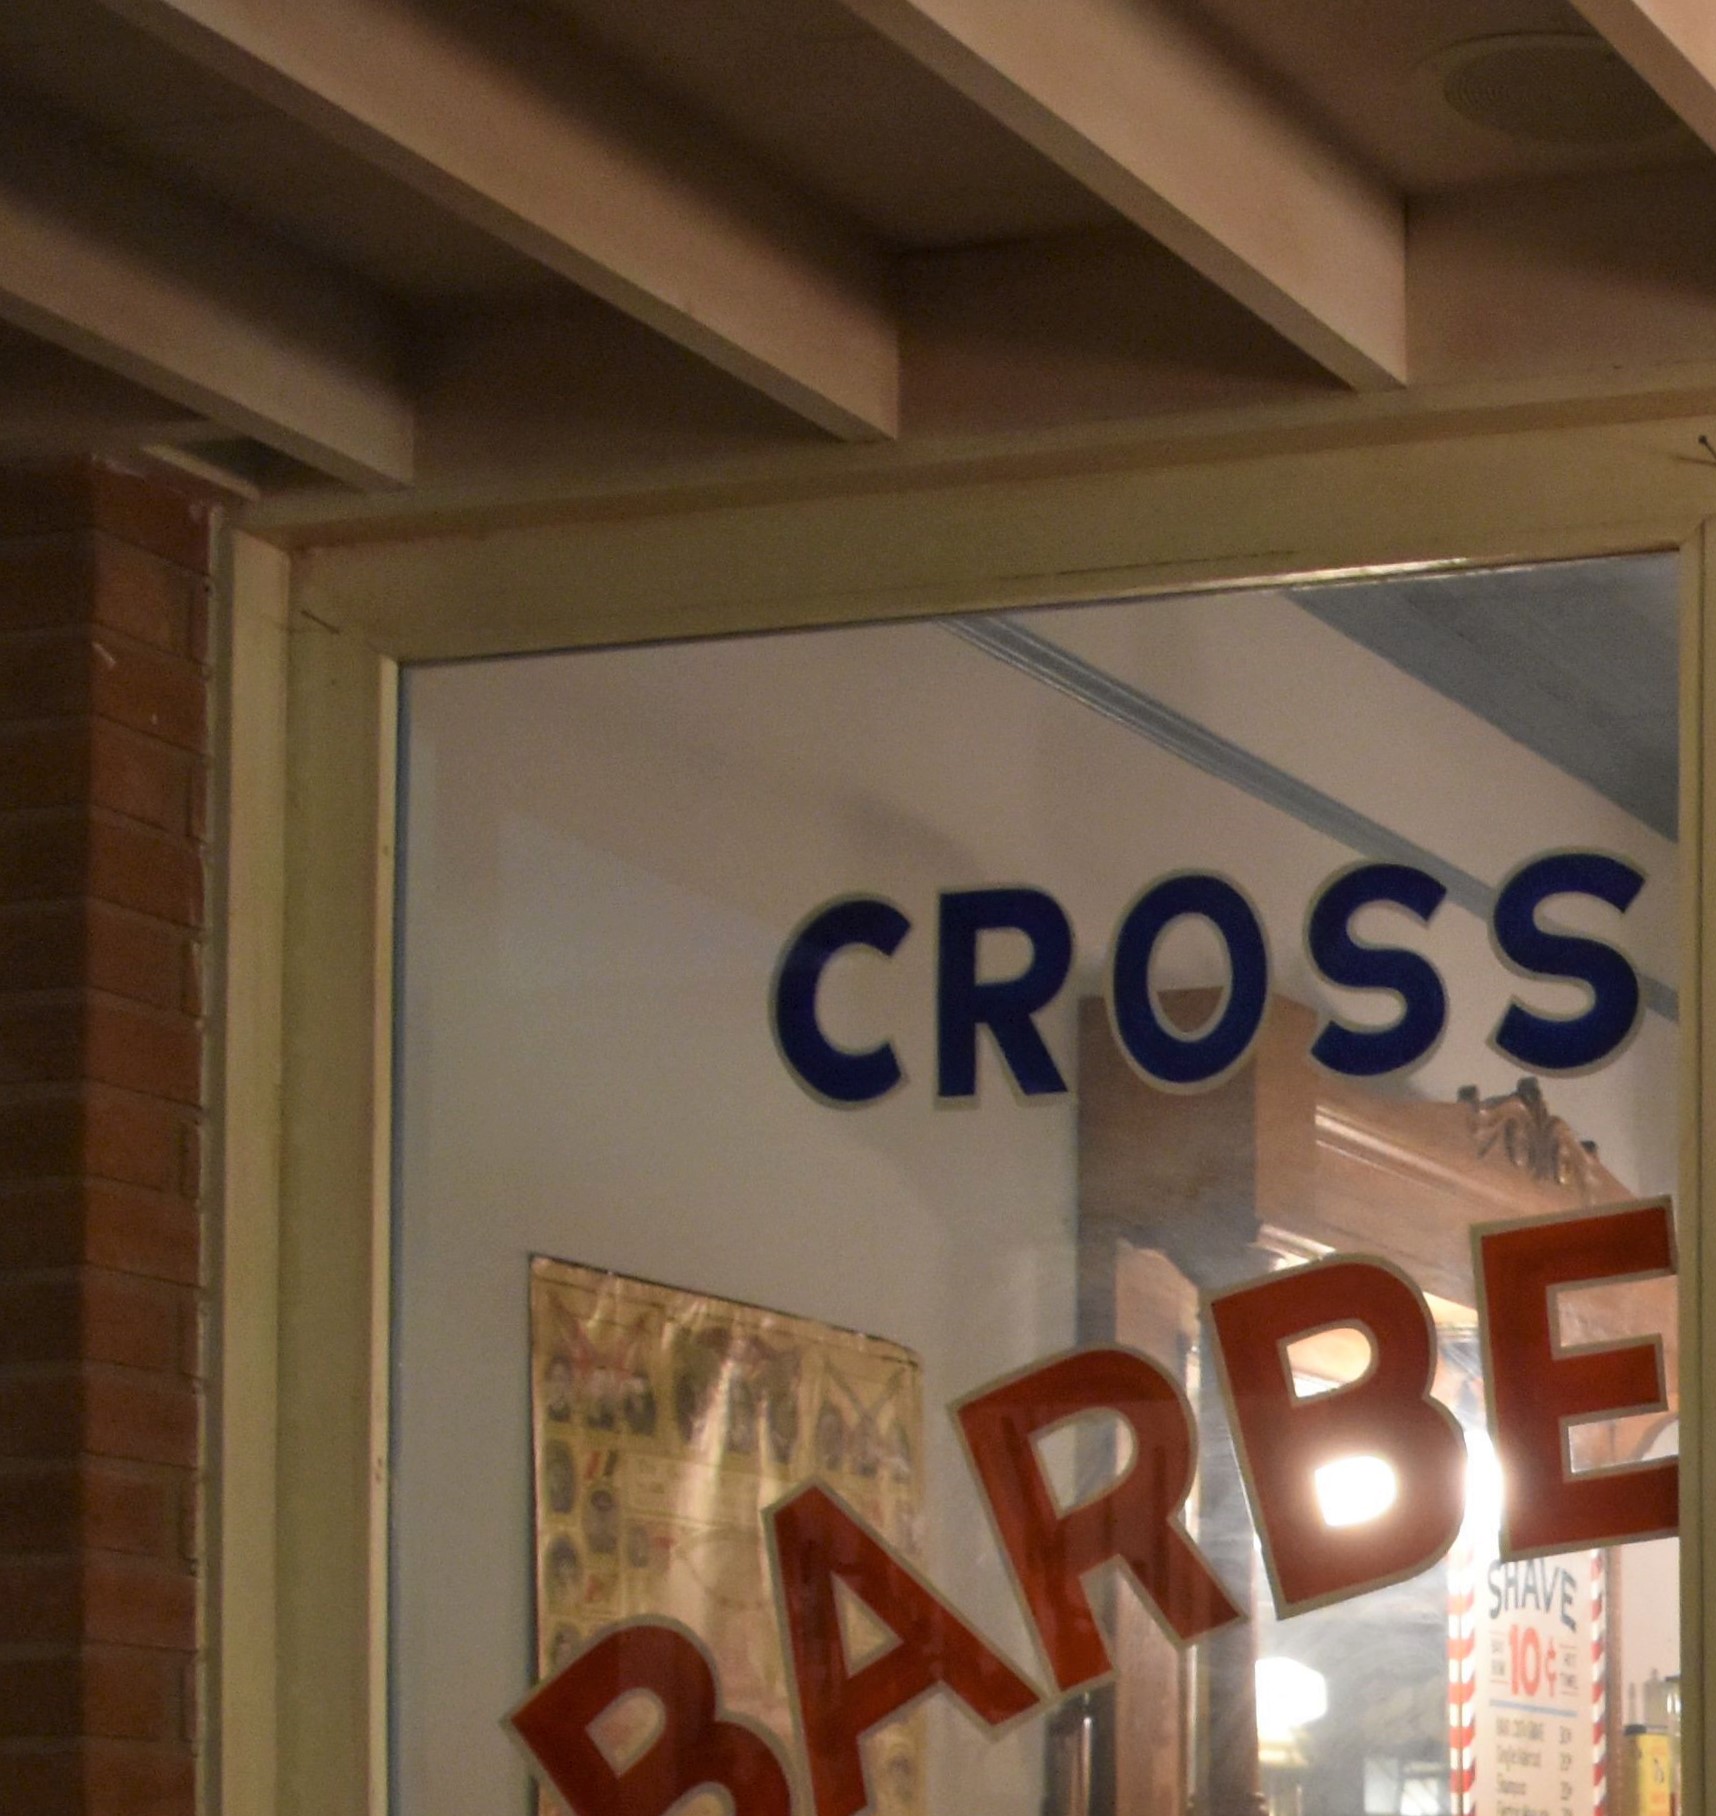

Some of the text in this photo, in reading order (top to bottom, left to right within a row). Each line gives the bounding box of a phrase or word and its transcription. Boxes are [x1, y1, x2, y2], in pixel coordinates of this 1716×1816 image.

[770, 850, 1648, 1105] CROSS
[1487, 1557, 1577, 1633] SHAVE
[1508, 1623, 1558, 1698] 10¢
